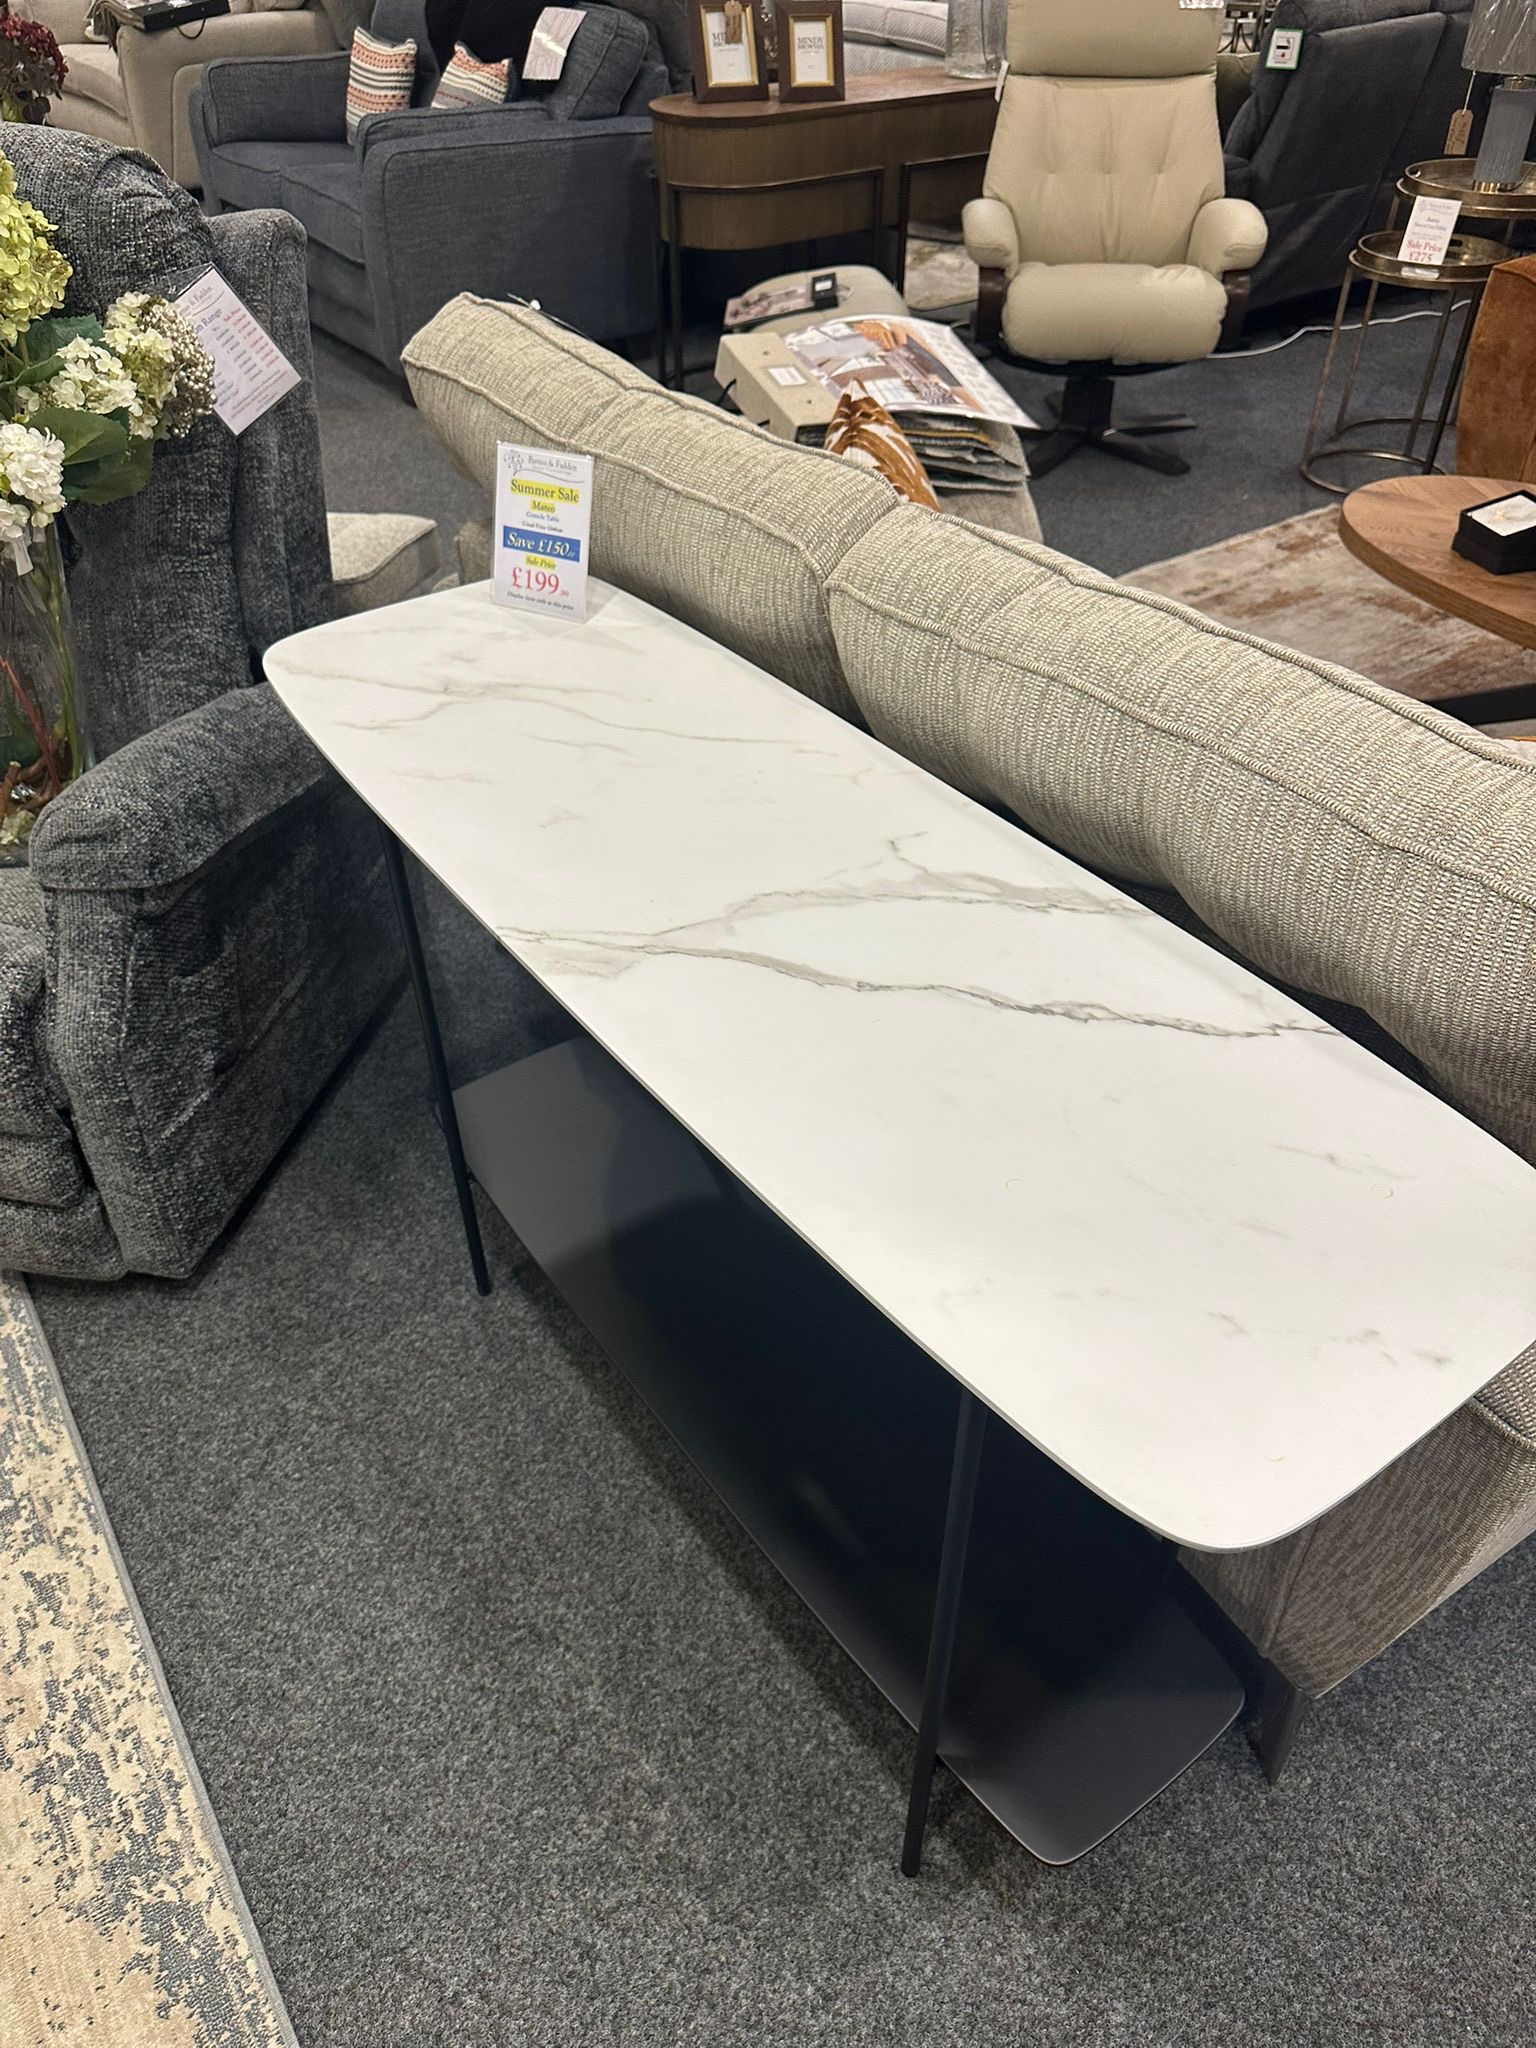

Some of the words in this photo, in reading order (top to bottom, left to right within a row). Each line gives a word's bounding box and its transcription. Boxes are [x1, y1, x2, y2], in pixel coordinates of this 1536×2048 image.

[1407, 240, 1422, 249] Sale
[1424, 242, 1442, 253] Price
[201, 307, 224, 327] Range
[511, 478, 556, 498] Summer
[558, 487, 580, 503] Sale
[507, 531, 535, 550] Save
[526, 556, 539, 567] Sale
[540, 559, 557, 570] Price
